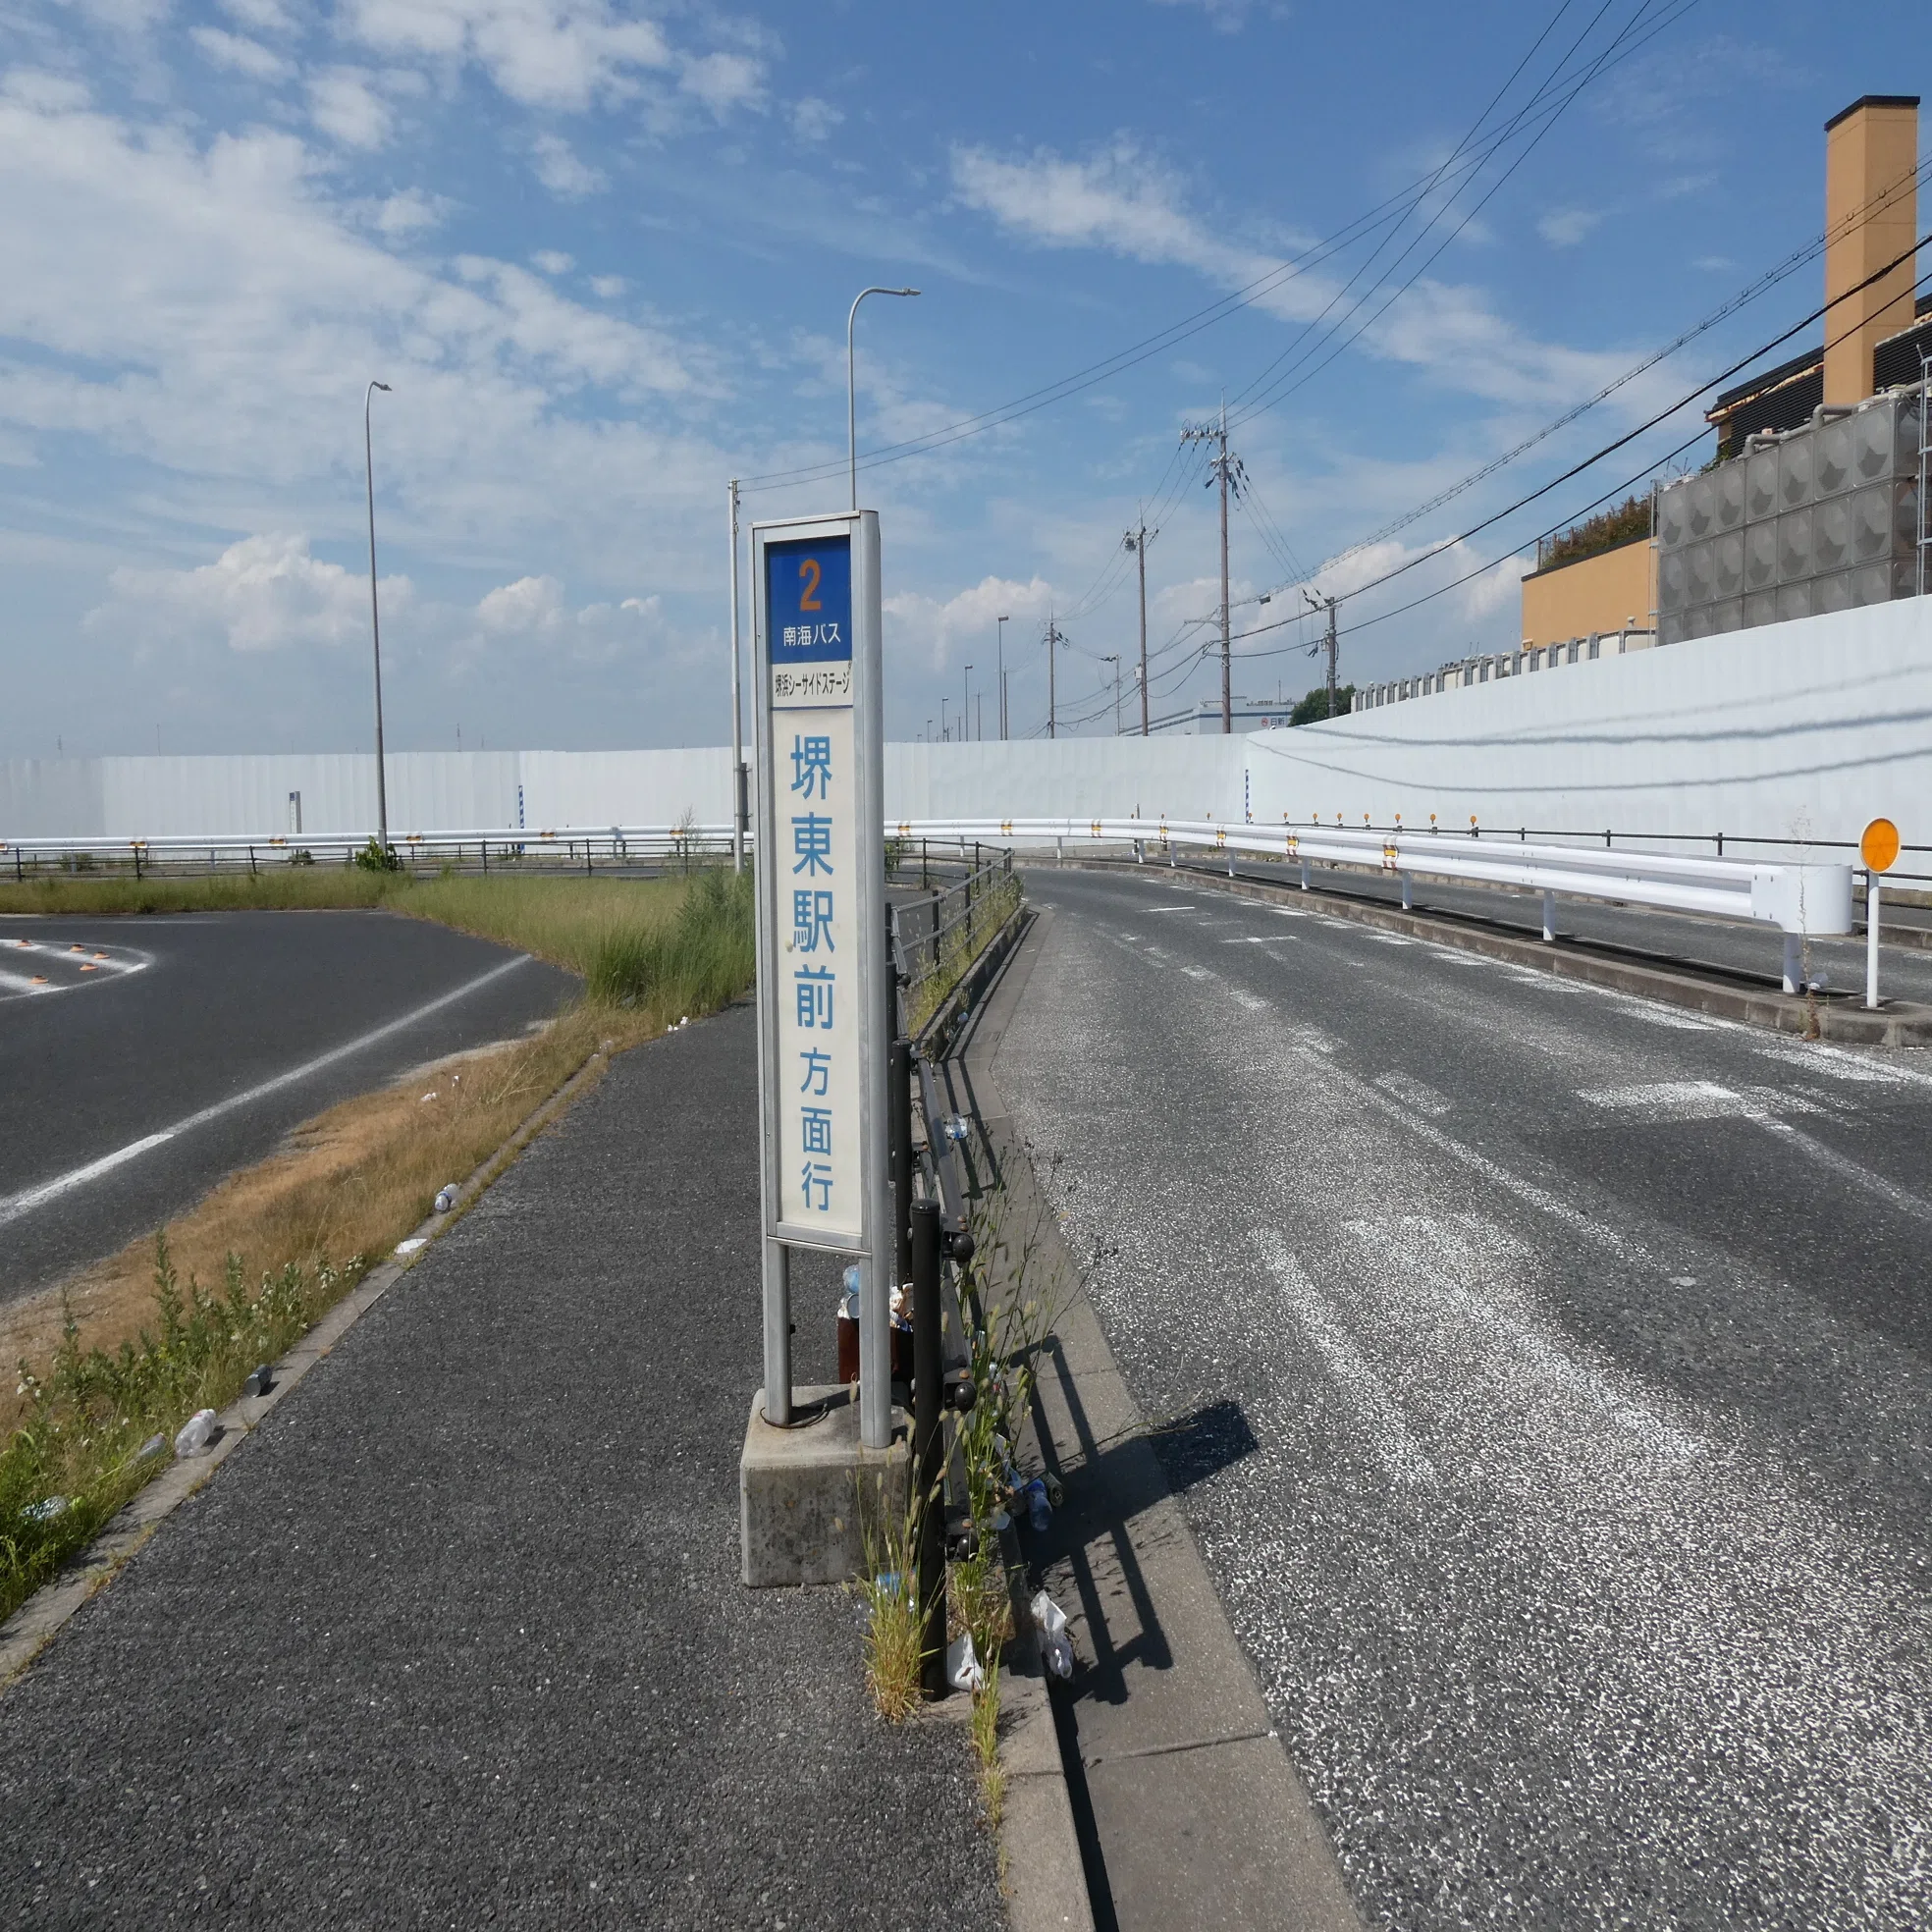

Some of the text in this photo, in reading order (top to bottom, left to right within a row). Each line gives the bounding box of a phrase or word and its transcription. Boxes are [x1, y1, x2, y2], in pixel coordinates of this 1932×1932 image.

[799, 559, 822, 611] 2
[783, 623, 841, 646] 南海バス
[790, 734, 835, 1211] 堺東駅前方面行
